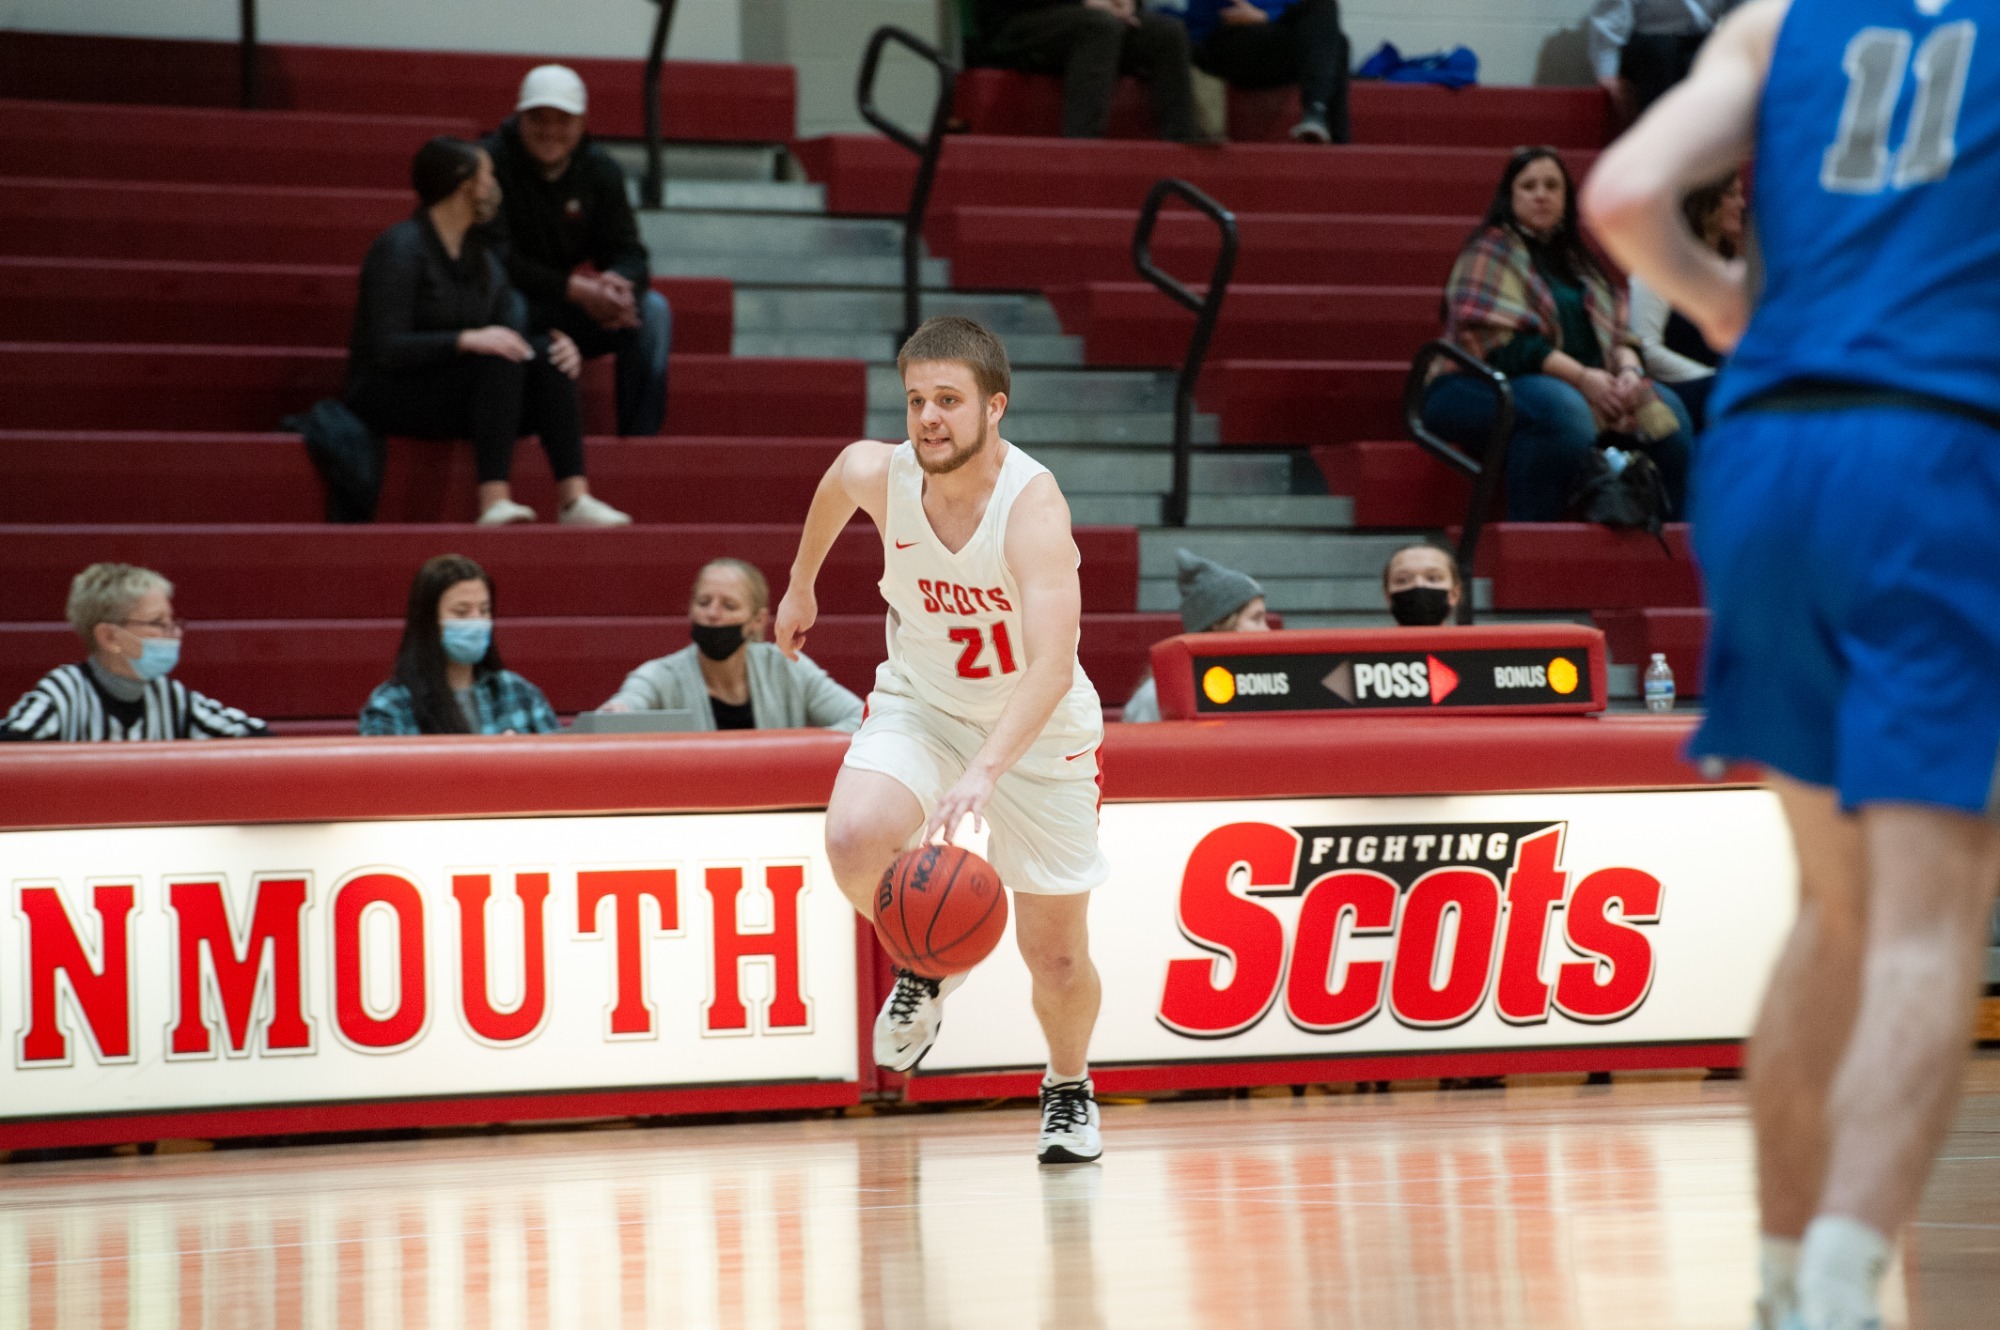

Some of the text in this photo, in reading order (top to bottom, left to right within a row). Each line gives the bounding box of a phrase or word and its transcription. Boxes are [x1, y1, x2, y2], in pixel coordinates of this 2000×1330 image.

[1819, 18, 1977, 195] 11
[918, 578, 1013, 616] SCOTS
[948, 619, 1019, 680] 21
[1235, 661, 1547, 700] BONUS POSS BONUS
[1309, 832, 1510, 864] FIGHTING
[12, 859, 816, 1070] NMOUTH
